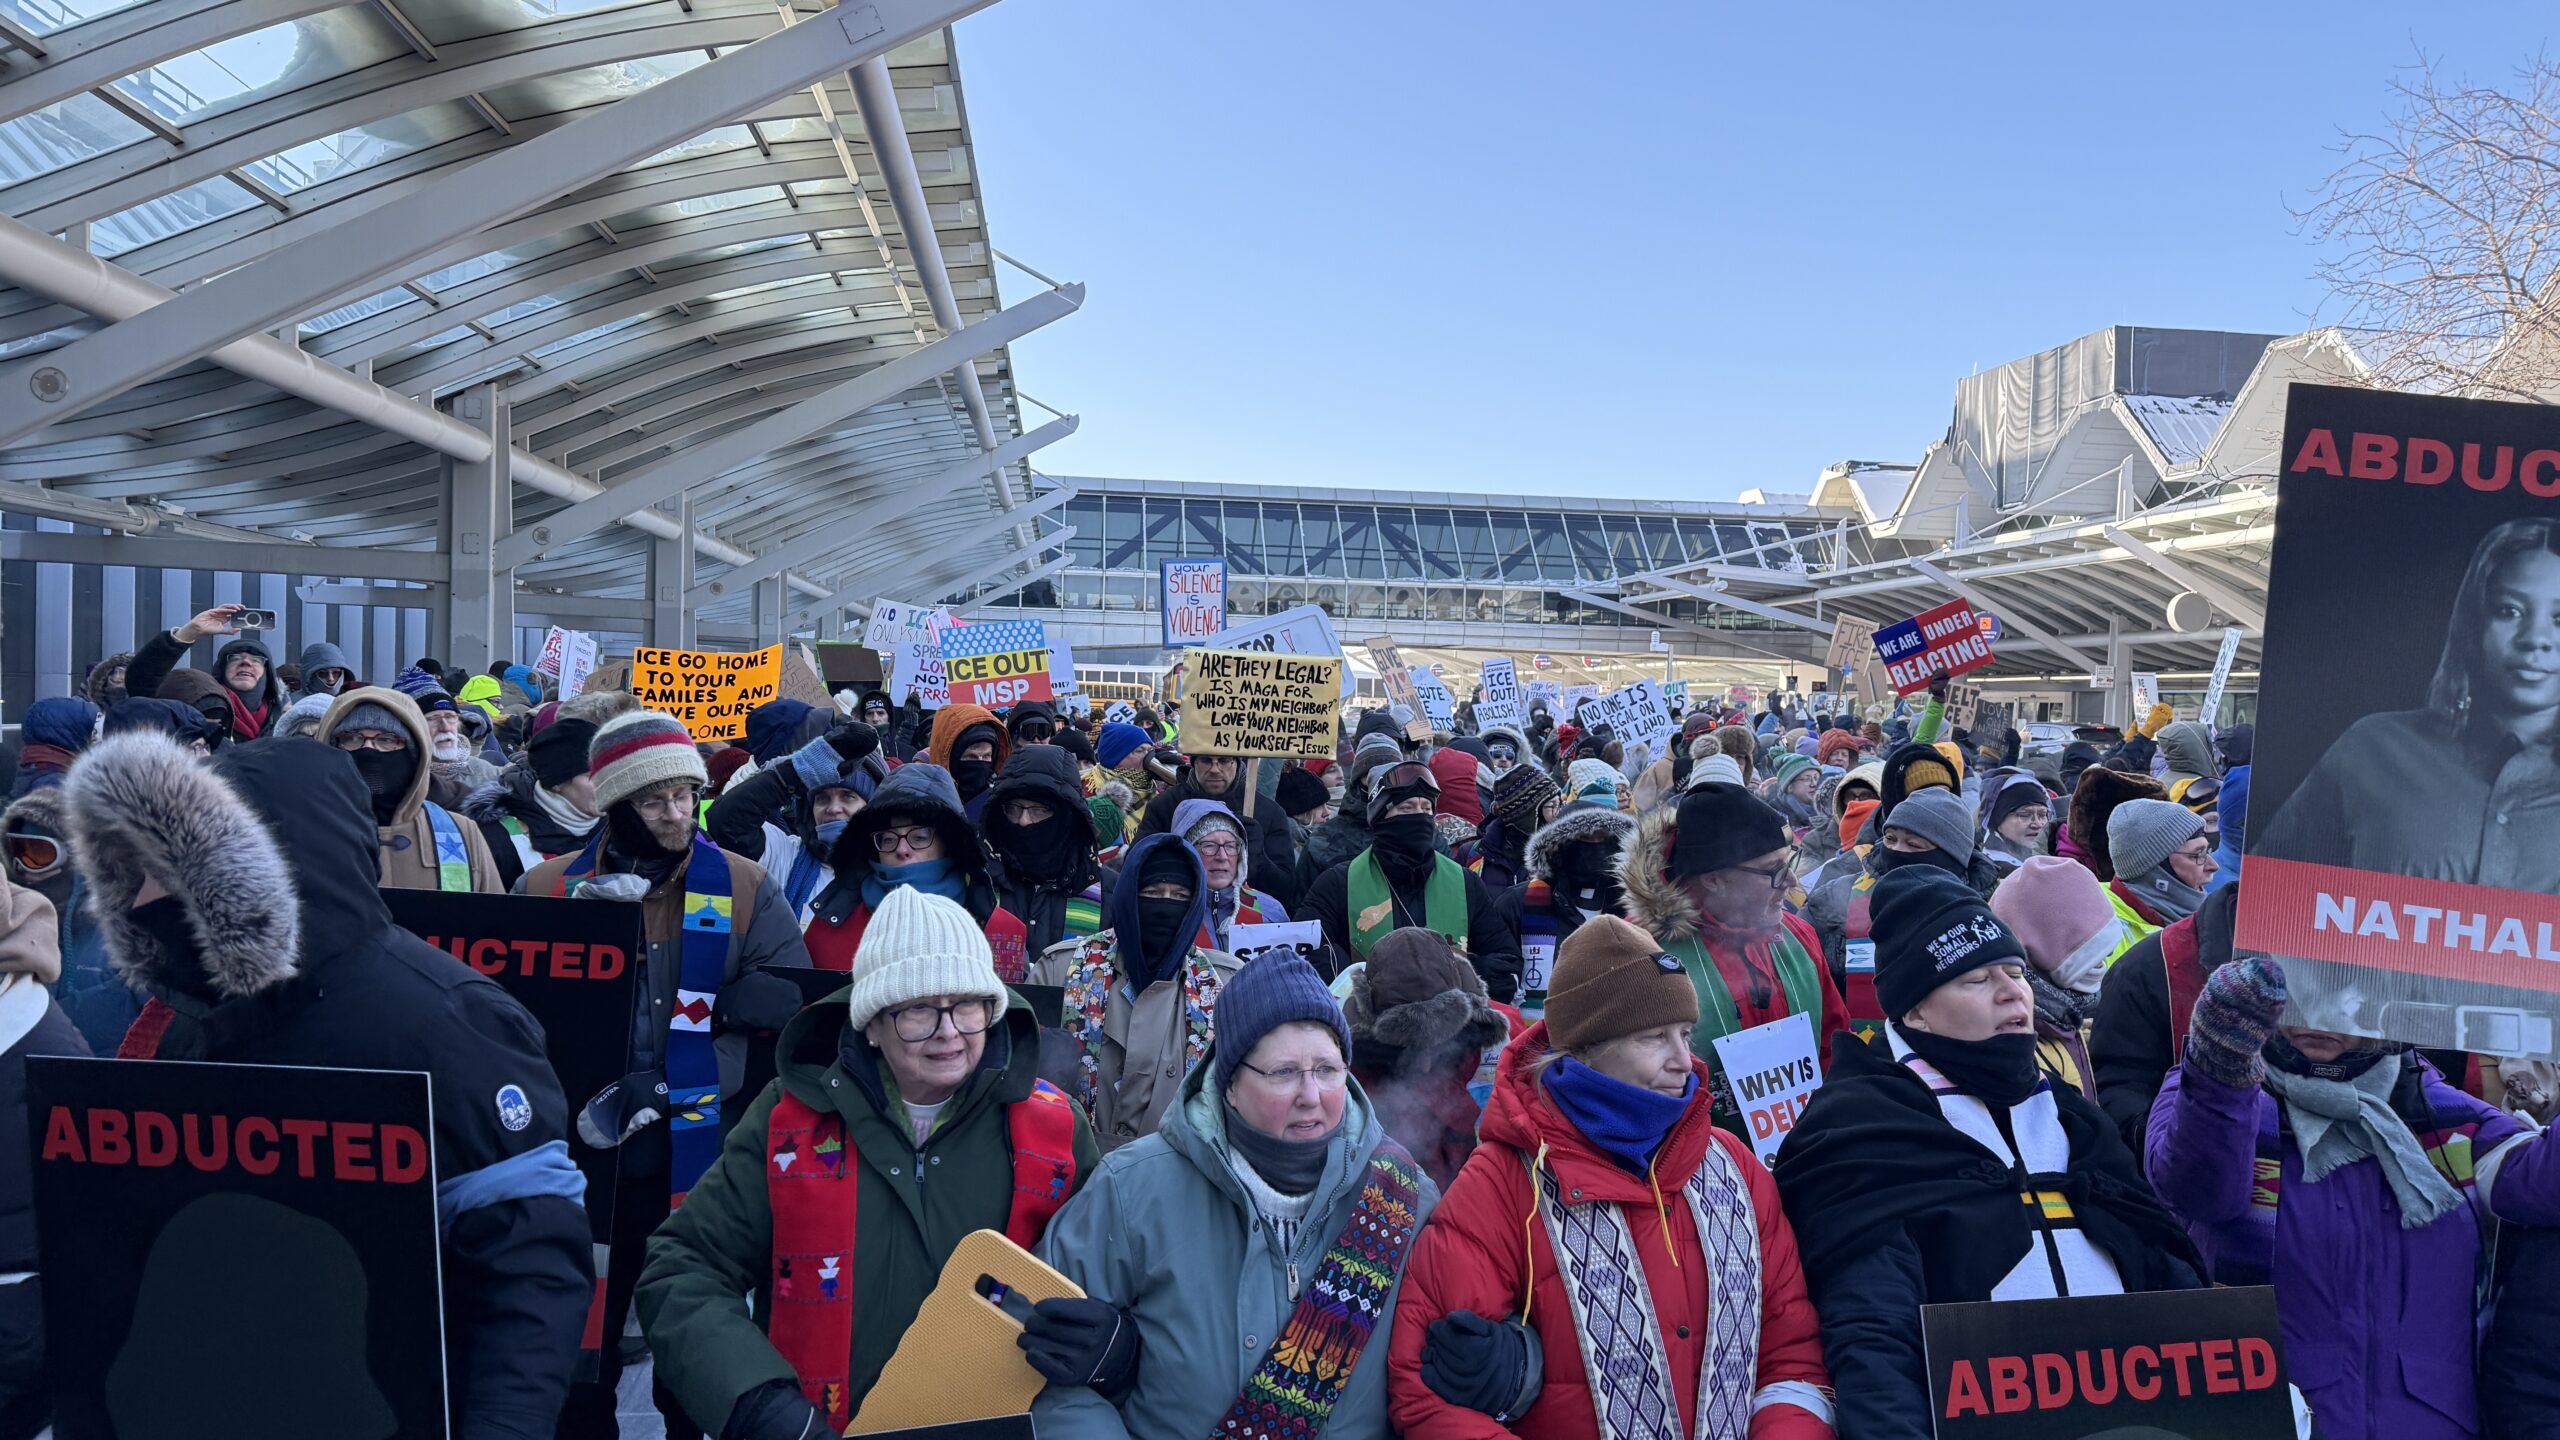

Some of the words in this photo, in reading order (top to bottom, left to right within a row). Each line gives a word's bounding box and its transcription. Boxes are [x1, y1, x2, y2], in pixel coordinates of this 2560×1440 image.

[2290, 428, 2560, 498] ABDUC
[1174, 564, 1209, 576] your
[1169, 572, 1222, 594] SILENCE
[876, 607, 896, 621] NO
[1923, 610, 1974, 641] UNDER
[1838, 621, 1874, 650] FIRE
[1879, 639, 1900, 658] WE
[1900, 631, 1921, 652] ARE
[636, 649, 671, 666] ICE
[678, 653, 706, 669] GO
[717, 651, 768, 670] HOME
[945, 656, 988, 682] ICE
[993, 649, 1046, 676] OUT
[1233, 656, 1271, 679] THEY
[1372, 646, 1402, 673] GIVE
[1890, 634, 1988, 688] REACTING
[646, 670, 674, 686] TO
[682, 672, 736, 688] YOUR
[1209, 679, 1233, 695] IS
[1240, 680, 1279, 697] MAGA
[1285, 685, 1313, 698] FOR
[1487, 672, 1513, 687] ICE
[1664, 681, 1687, 695] OUT
[633, 687, 717, 703] FAMILES
[738, 684, 773, 701] AND
[973, 678, 1029, 706] MSP
[1414, 685, 1445, 701] CUTE
[1490, 687, 1516, 703] OUT!
[1581, 704, 1601, 724] NO
[1601, 694, 1625, 716] ONE
[1625, 683, 1648, 706] IS
[707, 702, 755, 719] OURS
[1227, 696, 1247, 711] IS
[1250, 698, 1270, 713] MY
[1477, 703, 1516, 723] ABOLISH
[1639, 700, 1656, 717] ON
[1210, 711, 1246, 727] LOVE
[1247, 711, 1274, 733] YOUR
[1276, 717, 1329, 736] NEIGHBOR
[1634, 714, 1666, 737] LAND
[1214, 731, 1230, 748] AS
[1925, 940, 1941, 953] WE
[1947, 923, 1968, 939] OUR
[2313, 892, 2560, 962] NATHAL
[1934, 935, 1968, 960] SOMALI
[1935, 940, 1980, 973] NEIGHBORS
[1736, 1061, 1796, 1102] WHY
[1797, 1056, 1814, 1083] IS
[41, 1105, 429, 1184] ABDUCTED
[1945, 1337, 2277, 1419] ABDUCTED
